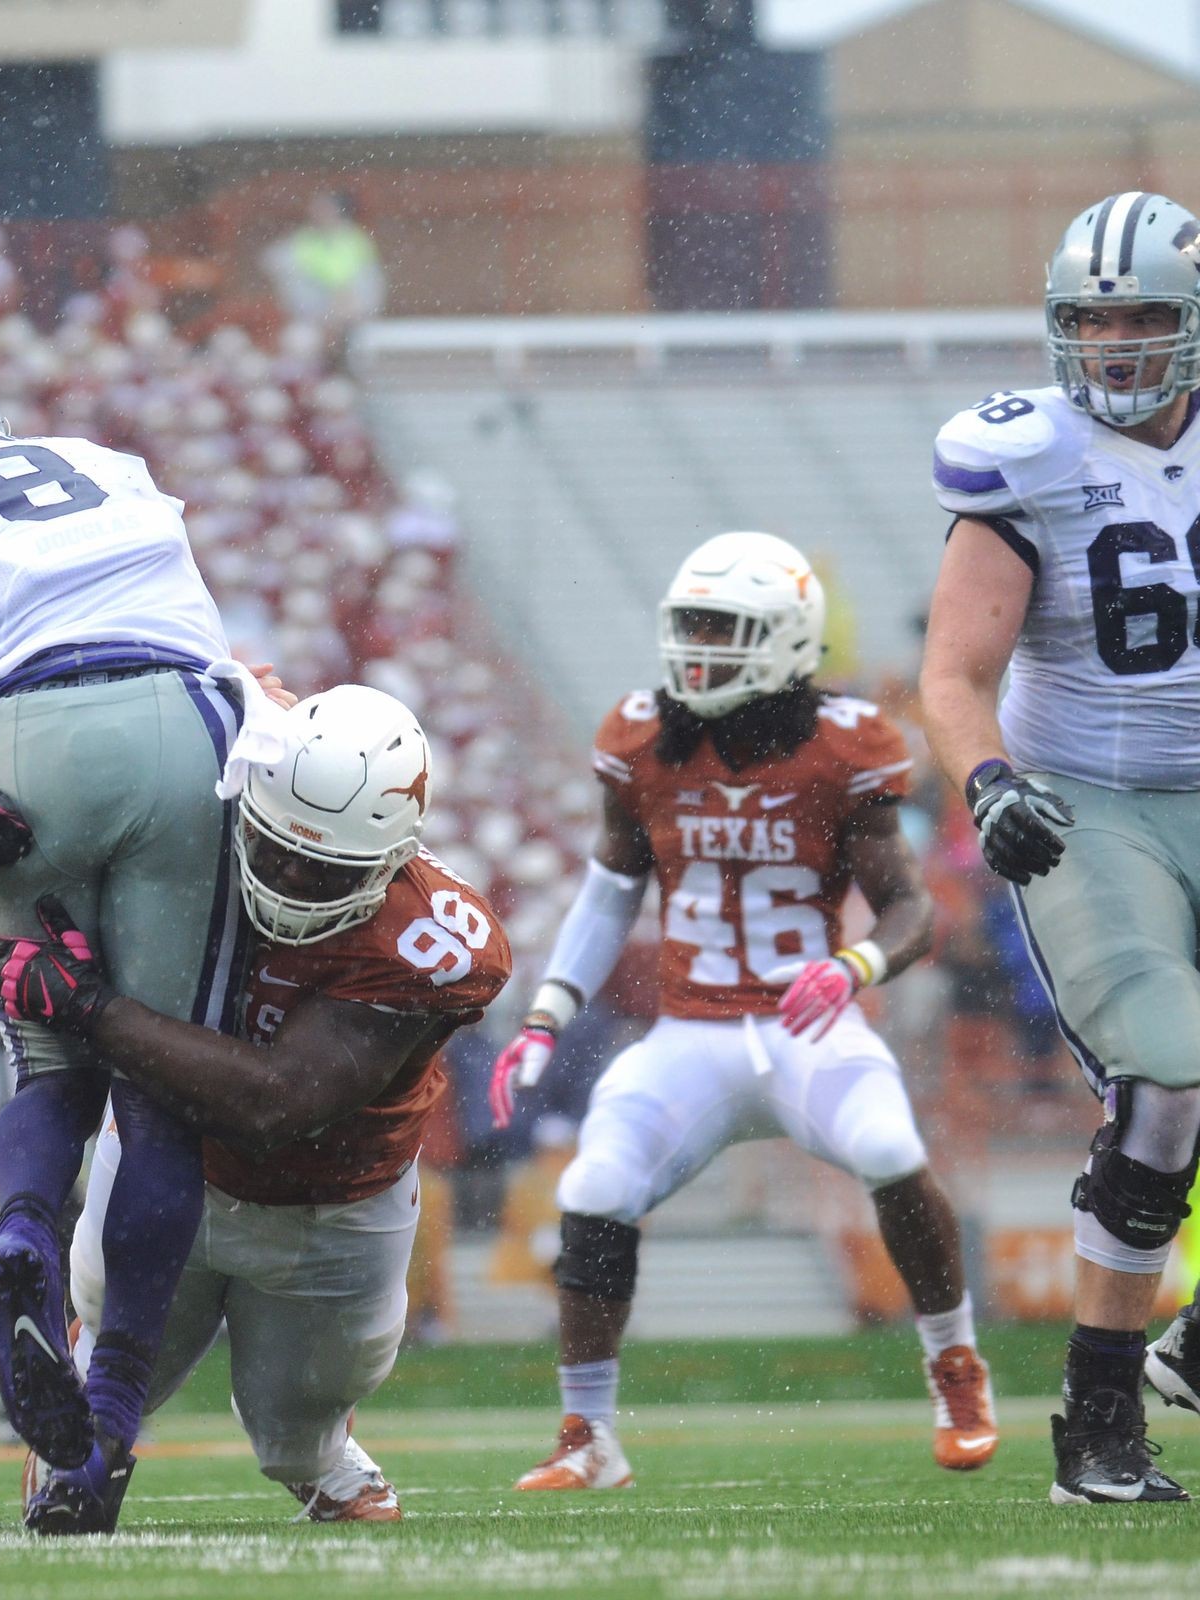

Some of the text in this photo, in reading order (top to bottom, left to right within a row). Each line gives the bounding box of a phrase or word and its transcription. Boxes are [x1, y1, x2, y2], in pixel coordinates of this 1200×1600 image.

[1082, 482, 1125, 510] XII
[1087, 521, 1200, 675] 6
[289, 821, 322, 841] HORNS
[676, 815, 796, 861] TEXAS
[397, 890, 491, 987] 98
[665, 861, 830, 985] 46
